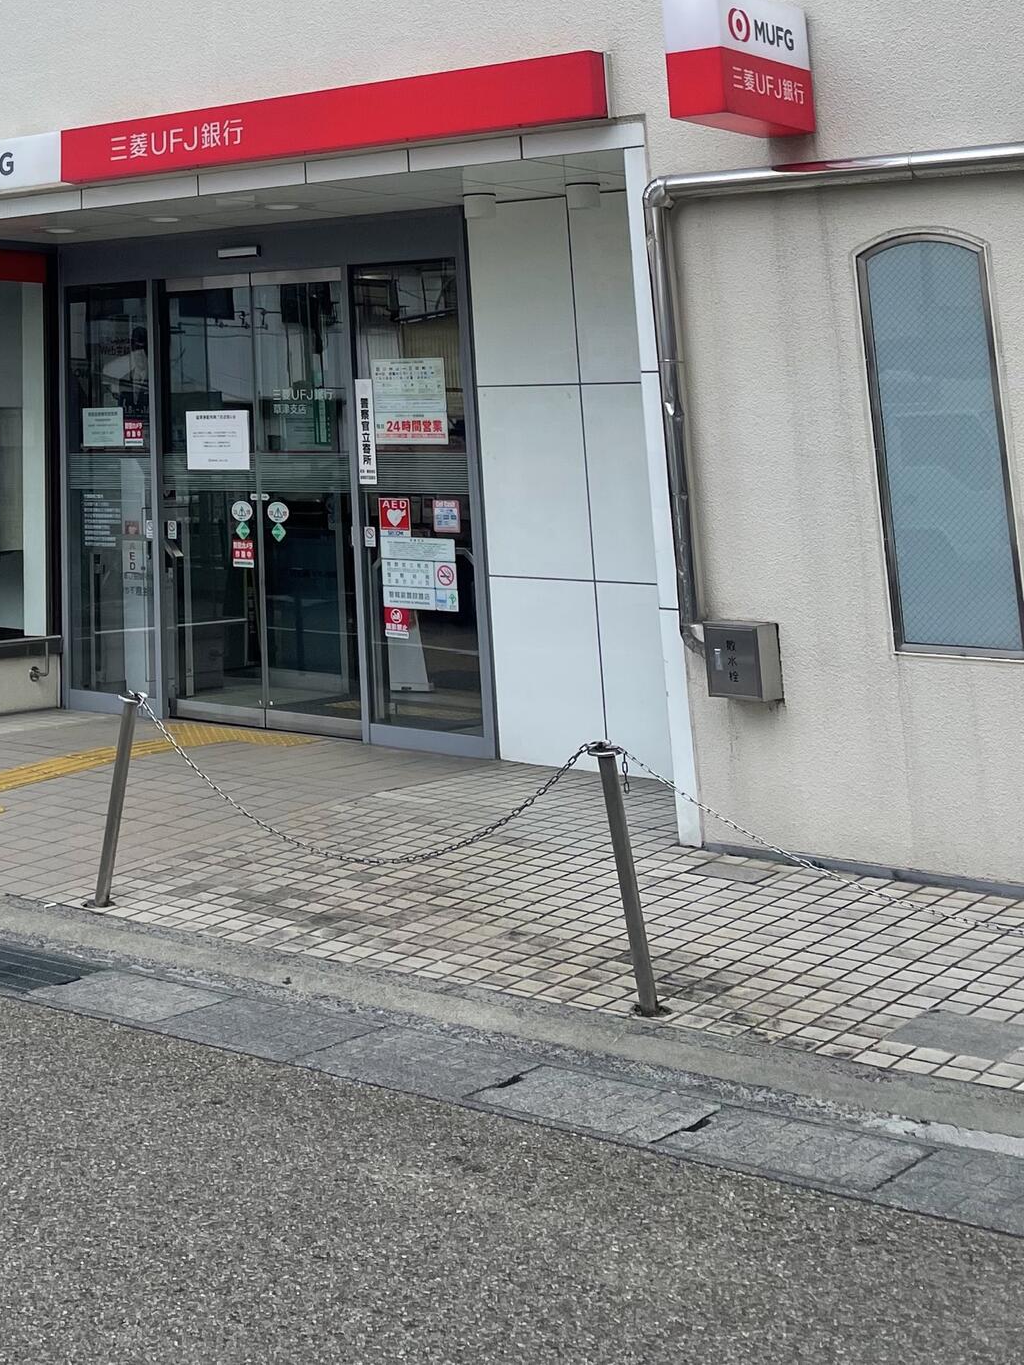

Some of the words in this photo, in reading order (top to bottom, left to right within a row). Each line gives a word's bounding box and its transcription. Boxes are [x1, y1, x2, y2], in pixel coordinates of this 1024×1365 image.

[754, 19, 794, 51] MUFG
[733, 66, 805, 105] 三菱UFJ銀行
[110, 119, 243, 162] 三菱UFJ銀行
[272, 388, 334, 401] 三菱UFJ銀行
[360, 397, 372, 466] 警察官立寄所
[386, 420, 443, 433] 24時間営業
[382, 500, 407, 509] AED
[725, 639, 739, 683] 散水栓
